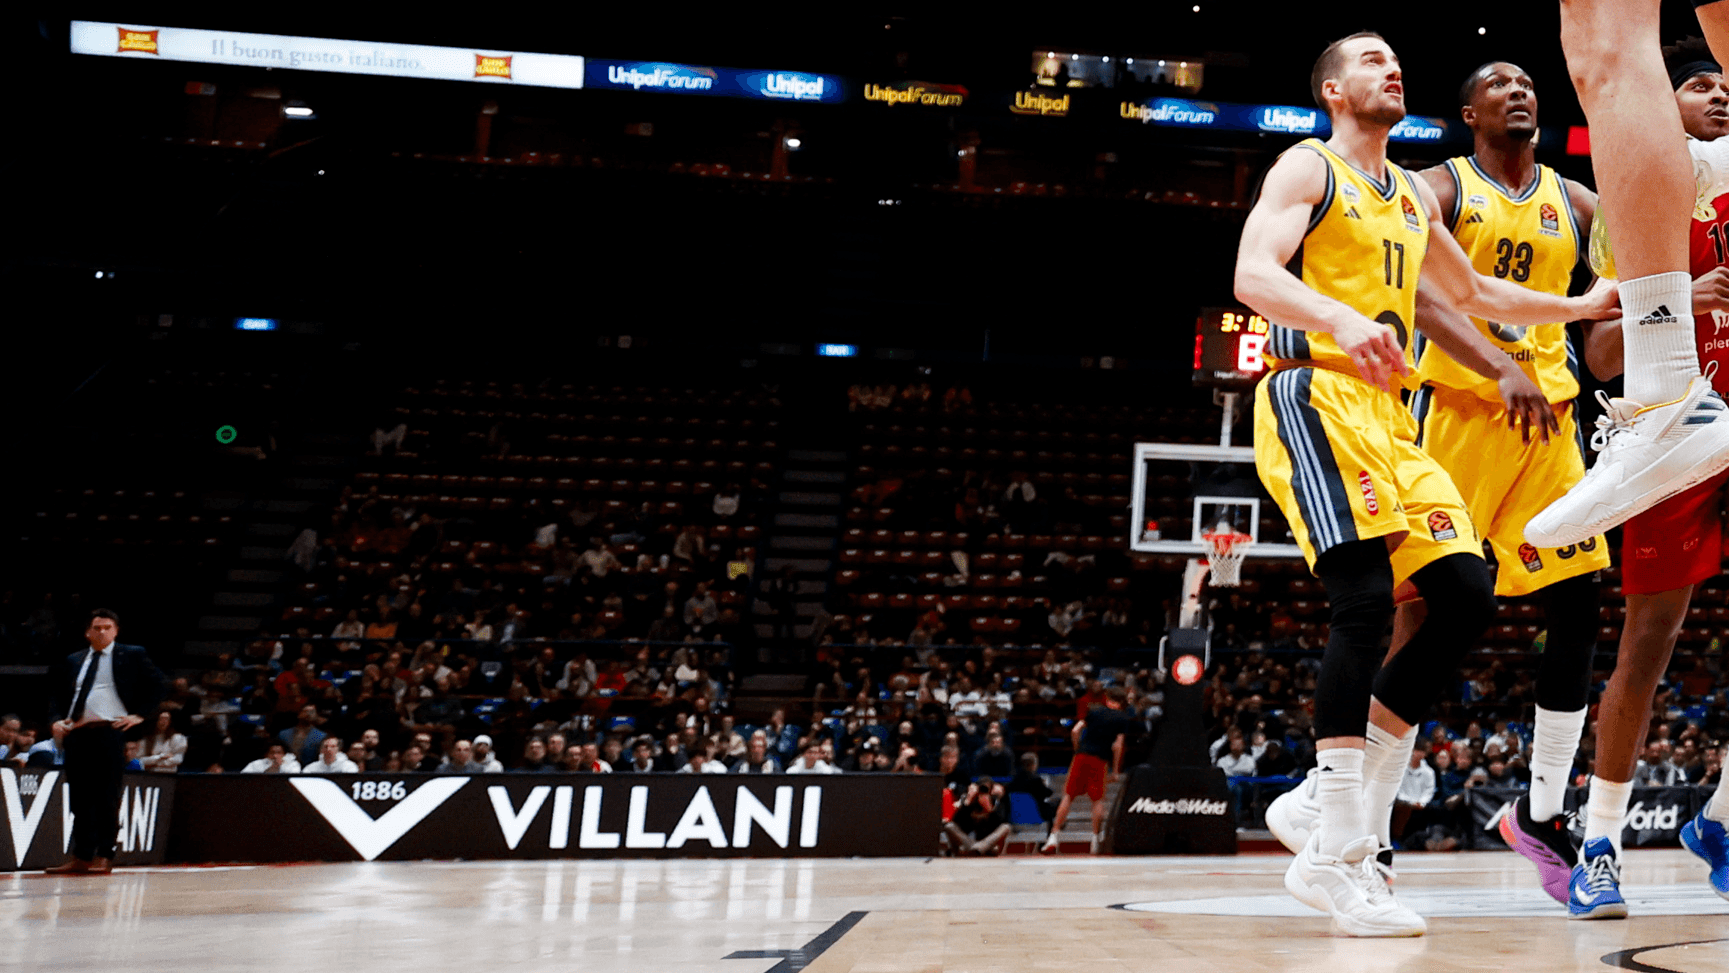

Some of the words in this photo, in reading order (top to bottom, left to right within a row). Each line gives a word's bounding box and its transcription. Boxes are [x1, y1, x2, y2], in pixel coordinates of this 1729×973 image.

[211, 39, 225, 55] Il
[232, 40, 284, 59] buon
[288, 50, 342, 67] gusto
[608, 65, 713, 90] UnipolForum
[767, 73, 824, 100] Unipol
[864, 83, 964, 106] UnipolForum
[1015, 91, 1070, 116] Unipol
[1120, 101, 1215, 124] UnipolForum
[1264, 108, 1316, 133] Unipol
[1382, 238, 1404, 290] 11
[1493, 237, 1534, 282] 33
[1221, 312, 1269, 334] 3:16
[1639, 316, 1678, 326] adidas
[1359, 475, 1379, 512] GAZI
[352, 781, 406, 801] 1886
[487, 785, 822, 850] VILLANI
